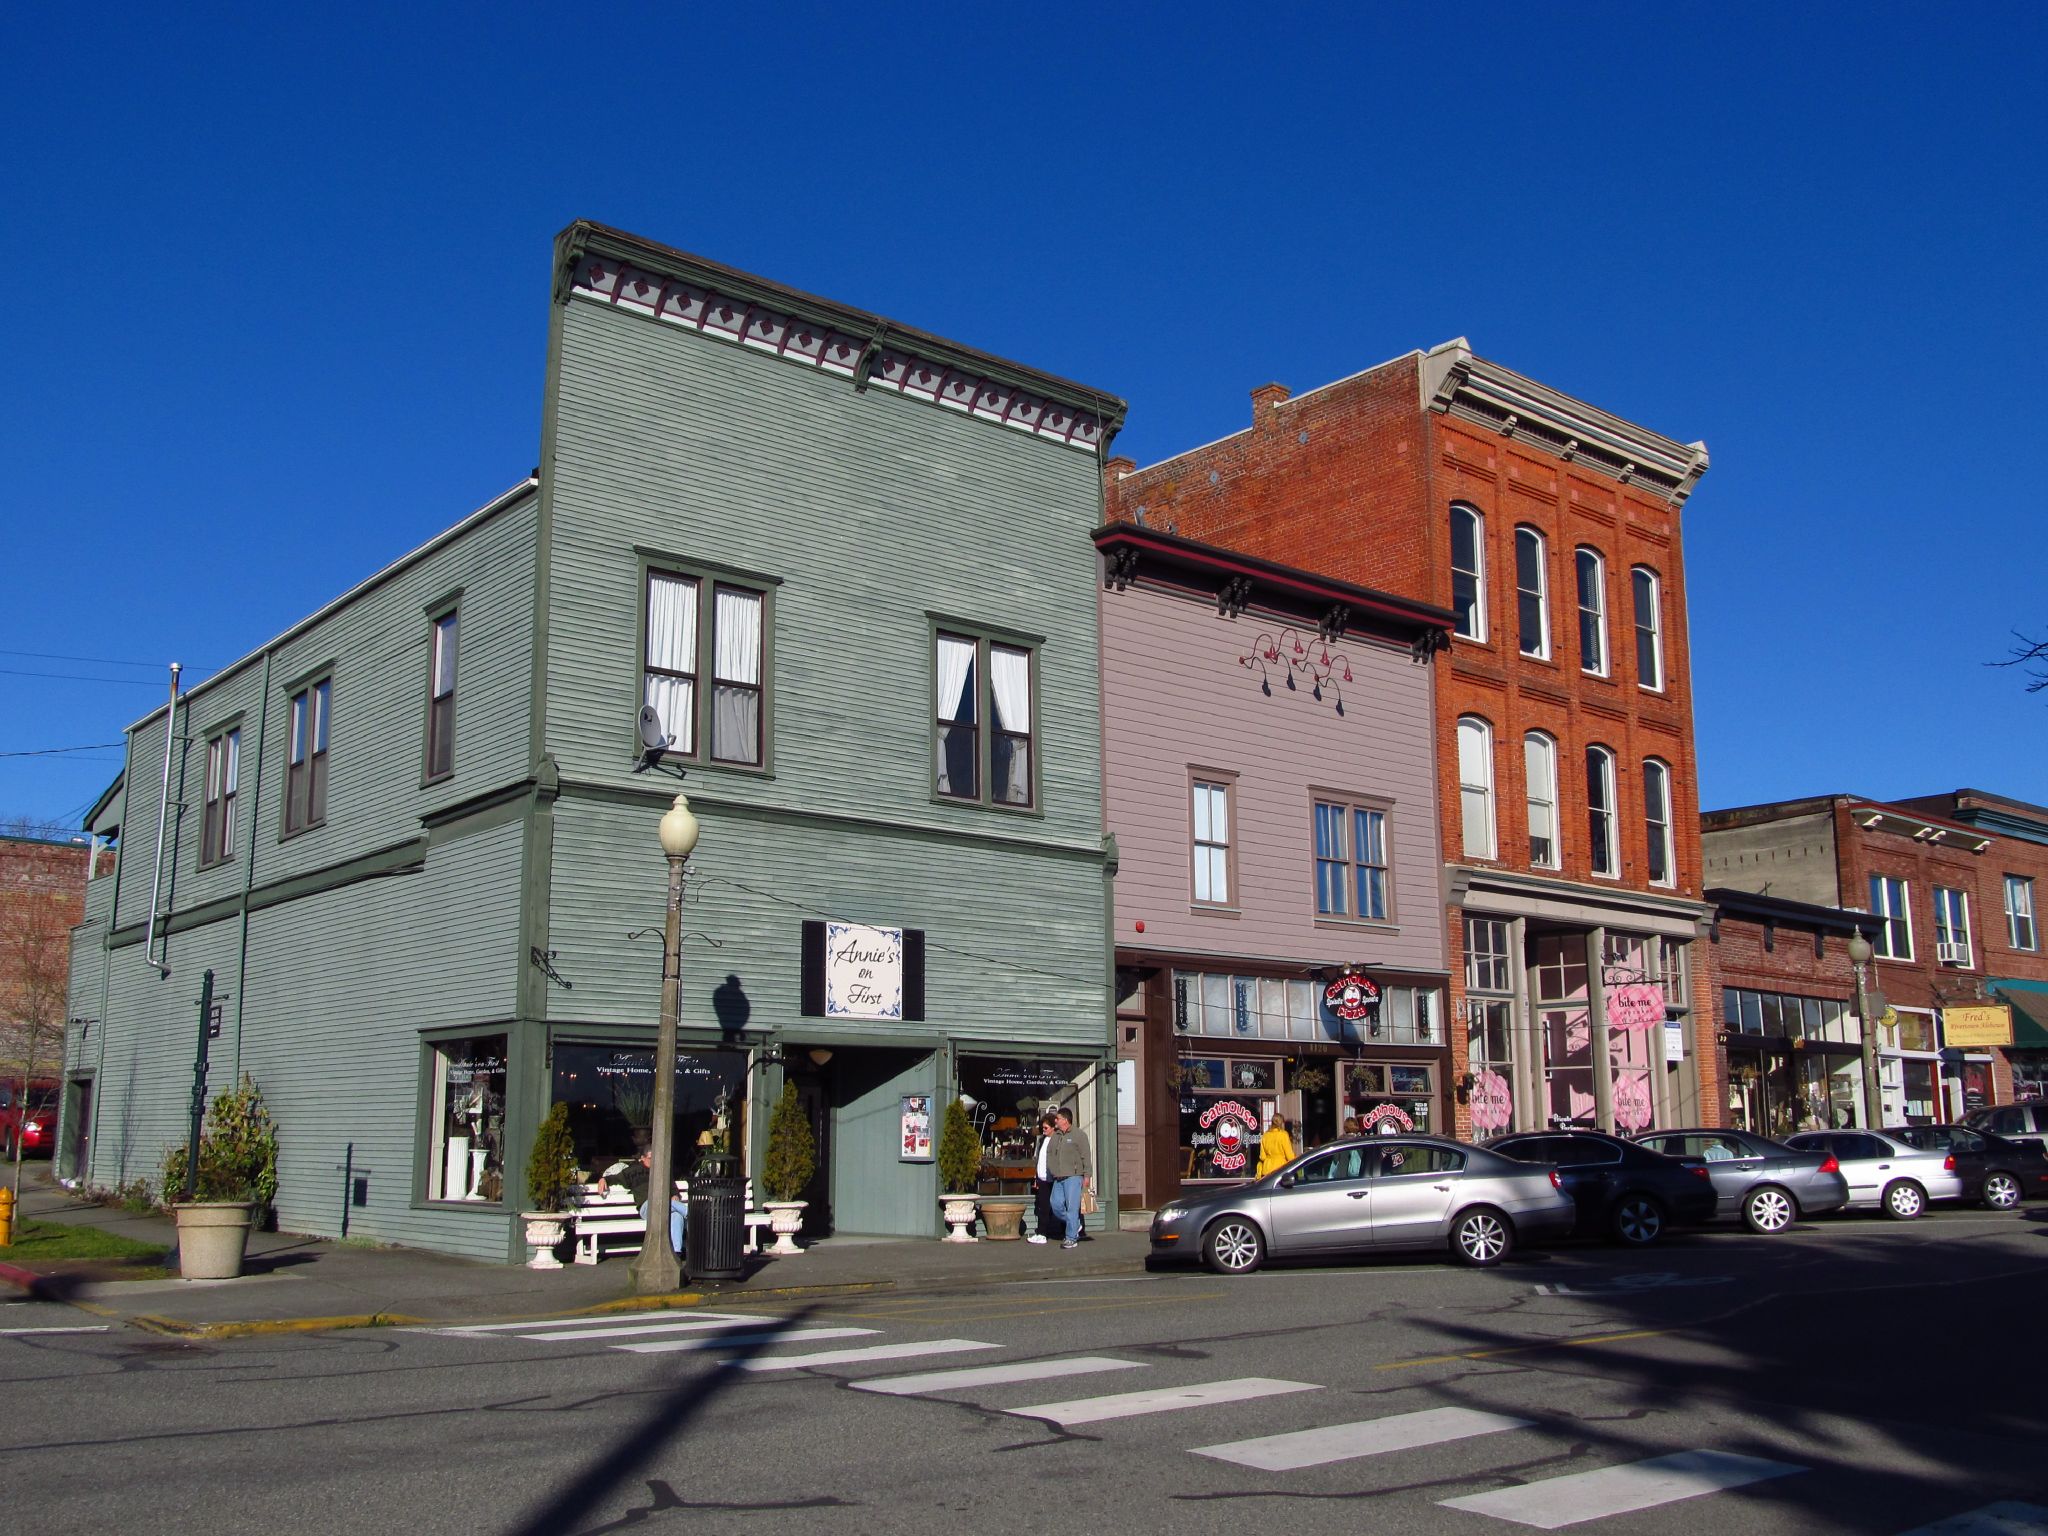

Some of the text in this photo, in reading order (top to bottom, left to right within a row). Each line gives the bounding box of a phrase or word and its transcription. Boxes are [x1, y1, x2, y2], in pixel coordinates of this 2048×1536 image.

[834, 939, 895, 967] Annie's
[858, 968, 874, 979] on
[847, 983, 882, 1004] First
[1326, 974, 1378, 999] Cathouse
[1617, 993, 1652, 1007] bite me
[1962, 1010, 1991, 1021] Fred's
[596, 1066, 625, 1075] Vintage
[626, 1066, 652, 1075] Home,
[1491, 1094, 1506, 1105] me
[1200, 1101, 1257, 1131] Cathouse
[1363, 1103, 1414, 1132] Cathouse
[1212, 1150, 1247, 1170] Pizza
